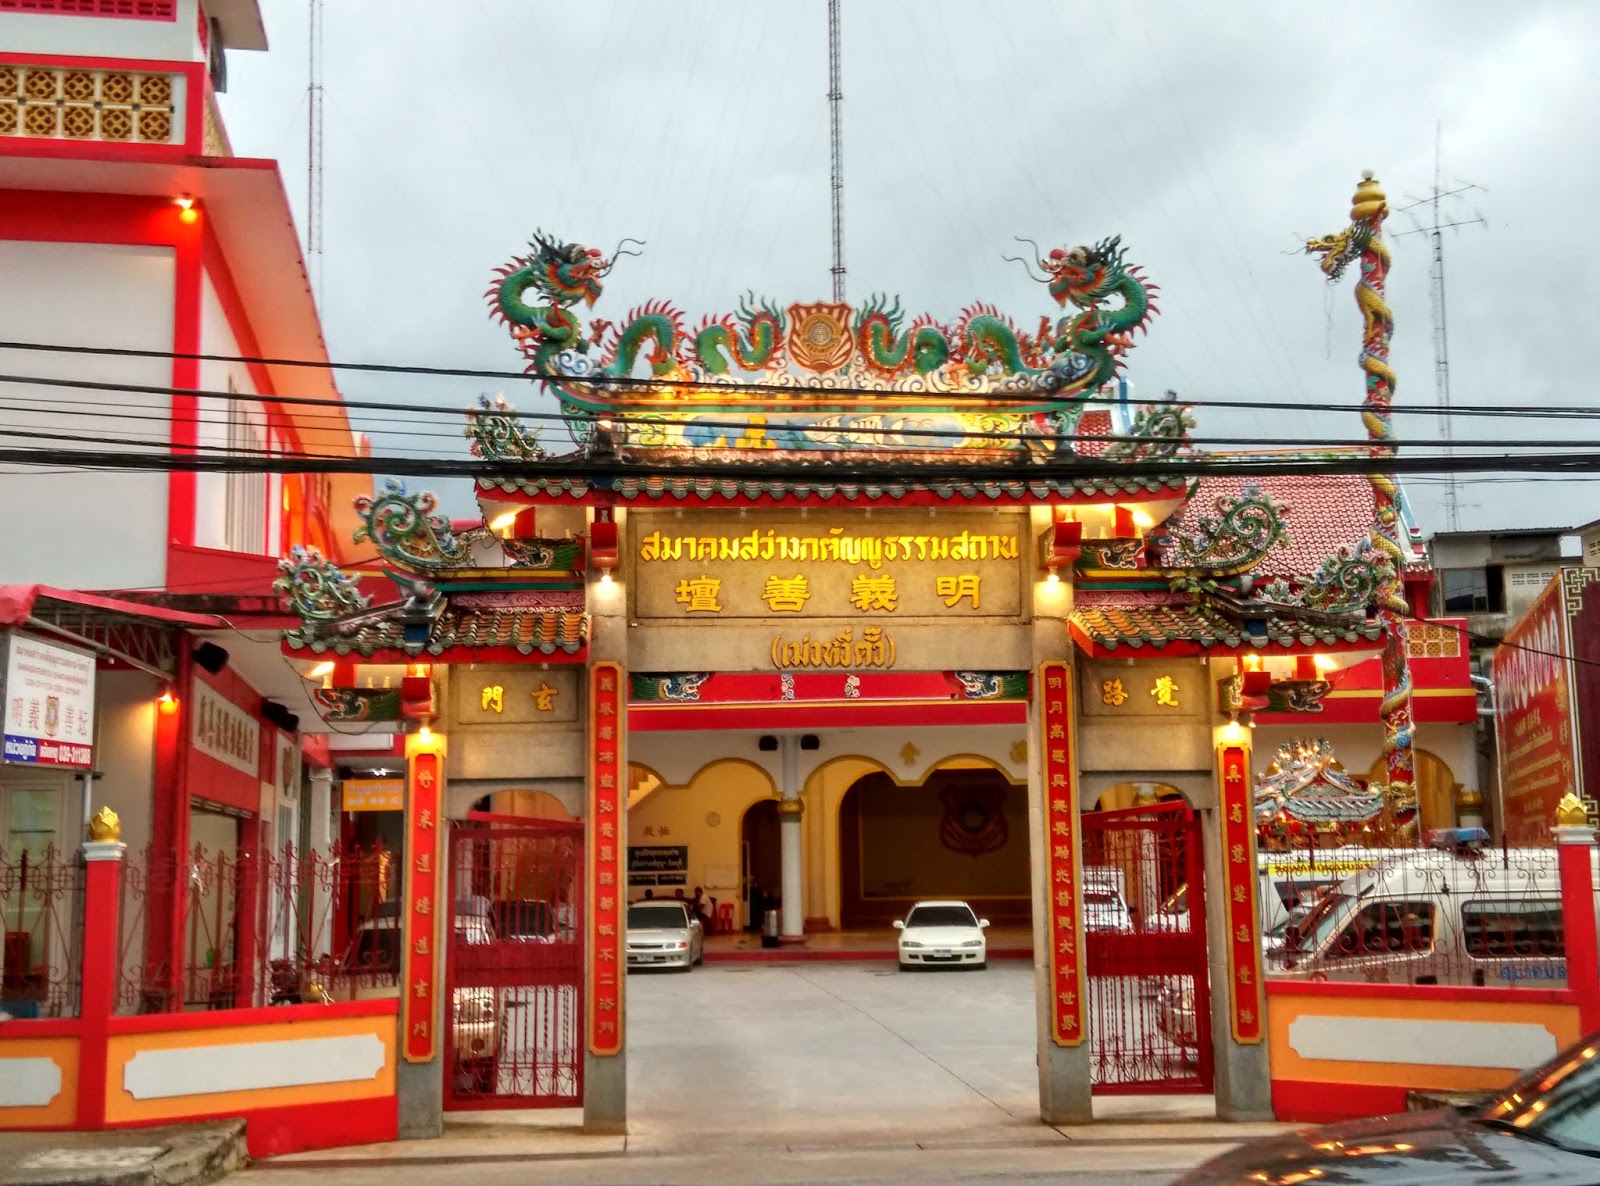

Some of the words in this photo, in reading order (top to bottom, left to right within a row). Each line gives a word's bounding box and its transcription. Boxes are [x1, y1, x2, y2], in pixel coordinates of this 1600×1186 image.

[640, 528, 1019, 569] สมาคมสว่างกตัญญูธรรมสถาน
